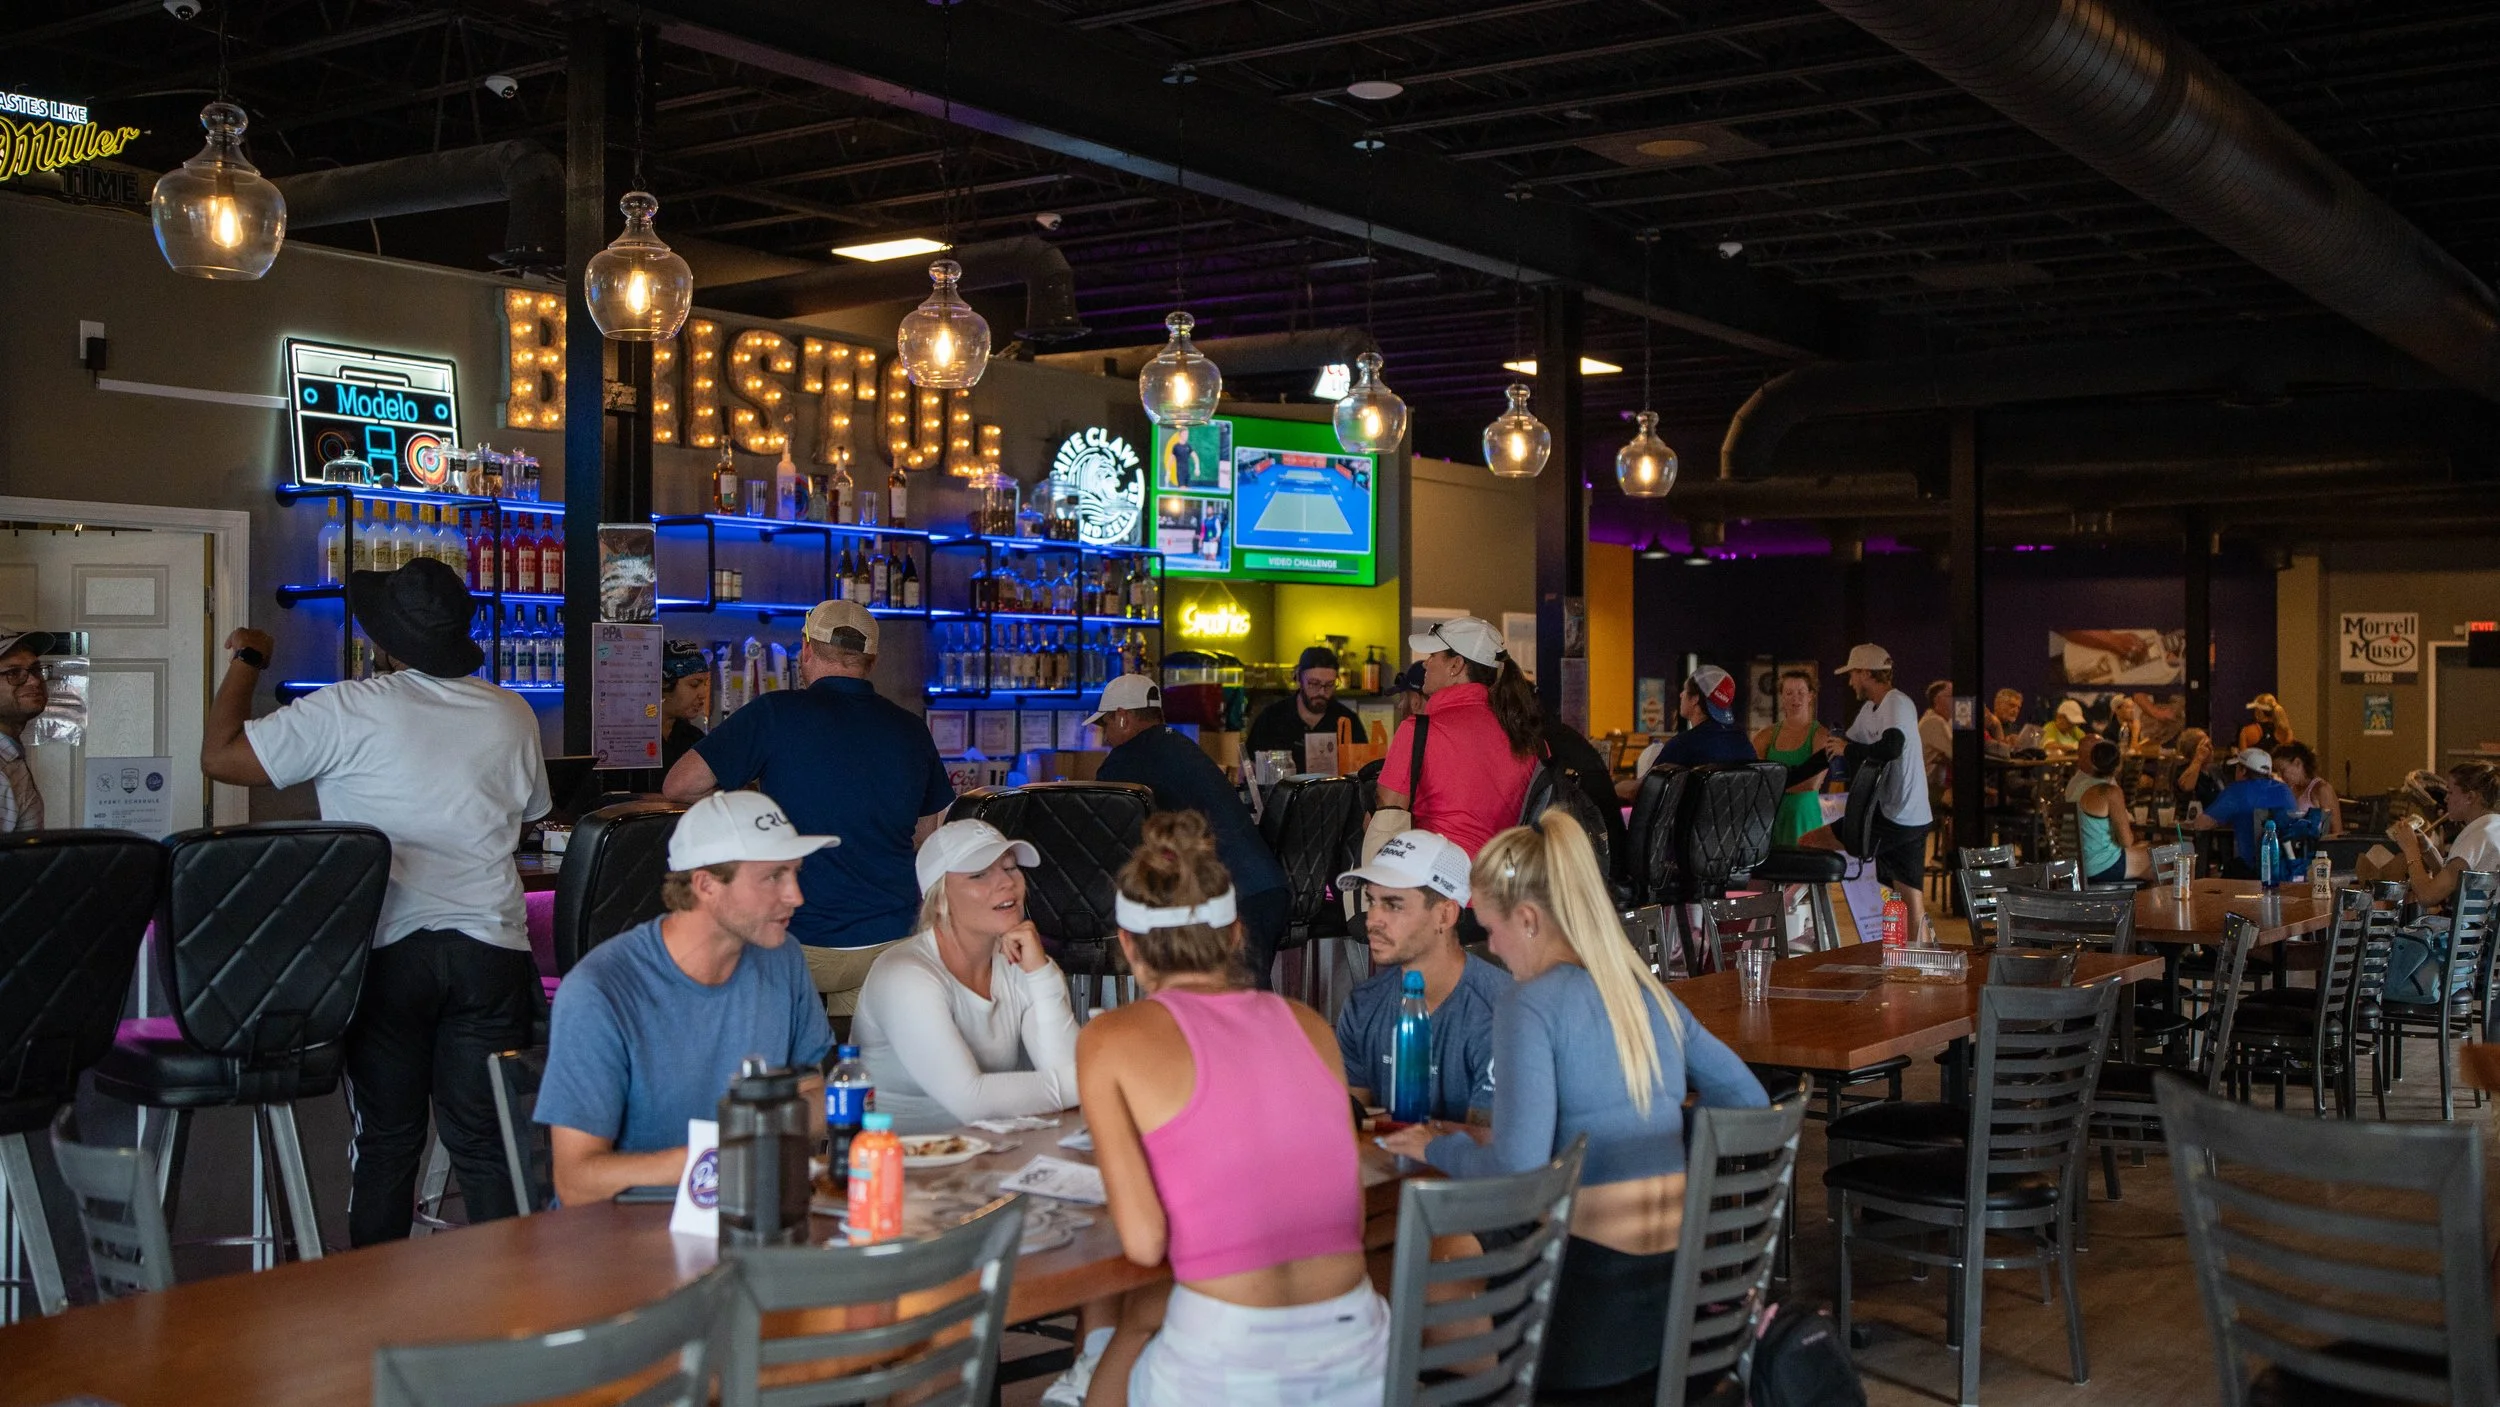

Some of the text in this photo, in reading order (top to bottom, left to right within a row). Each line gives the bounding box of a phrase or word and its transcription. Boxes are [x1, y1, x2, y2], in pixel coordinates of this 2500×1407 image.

[50, 100, 88, 124] LIKE
[63, 167, 138, 203] TIME
[335, 383, 419, 423] Modelo
[1085, 427, 1140, 468] CLAW
[1268, 556, 1338, 570] VIDEO CHALLENGE
[2342, 616, 2416, 644] Morrell
[2350, 640, 2409, 660] Music
[2363, 672, 2394, 684] STAGE
[2317, 884, 2327, 893] 26
